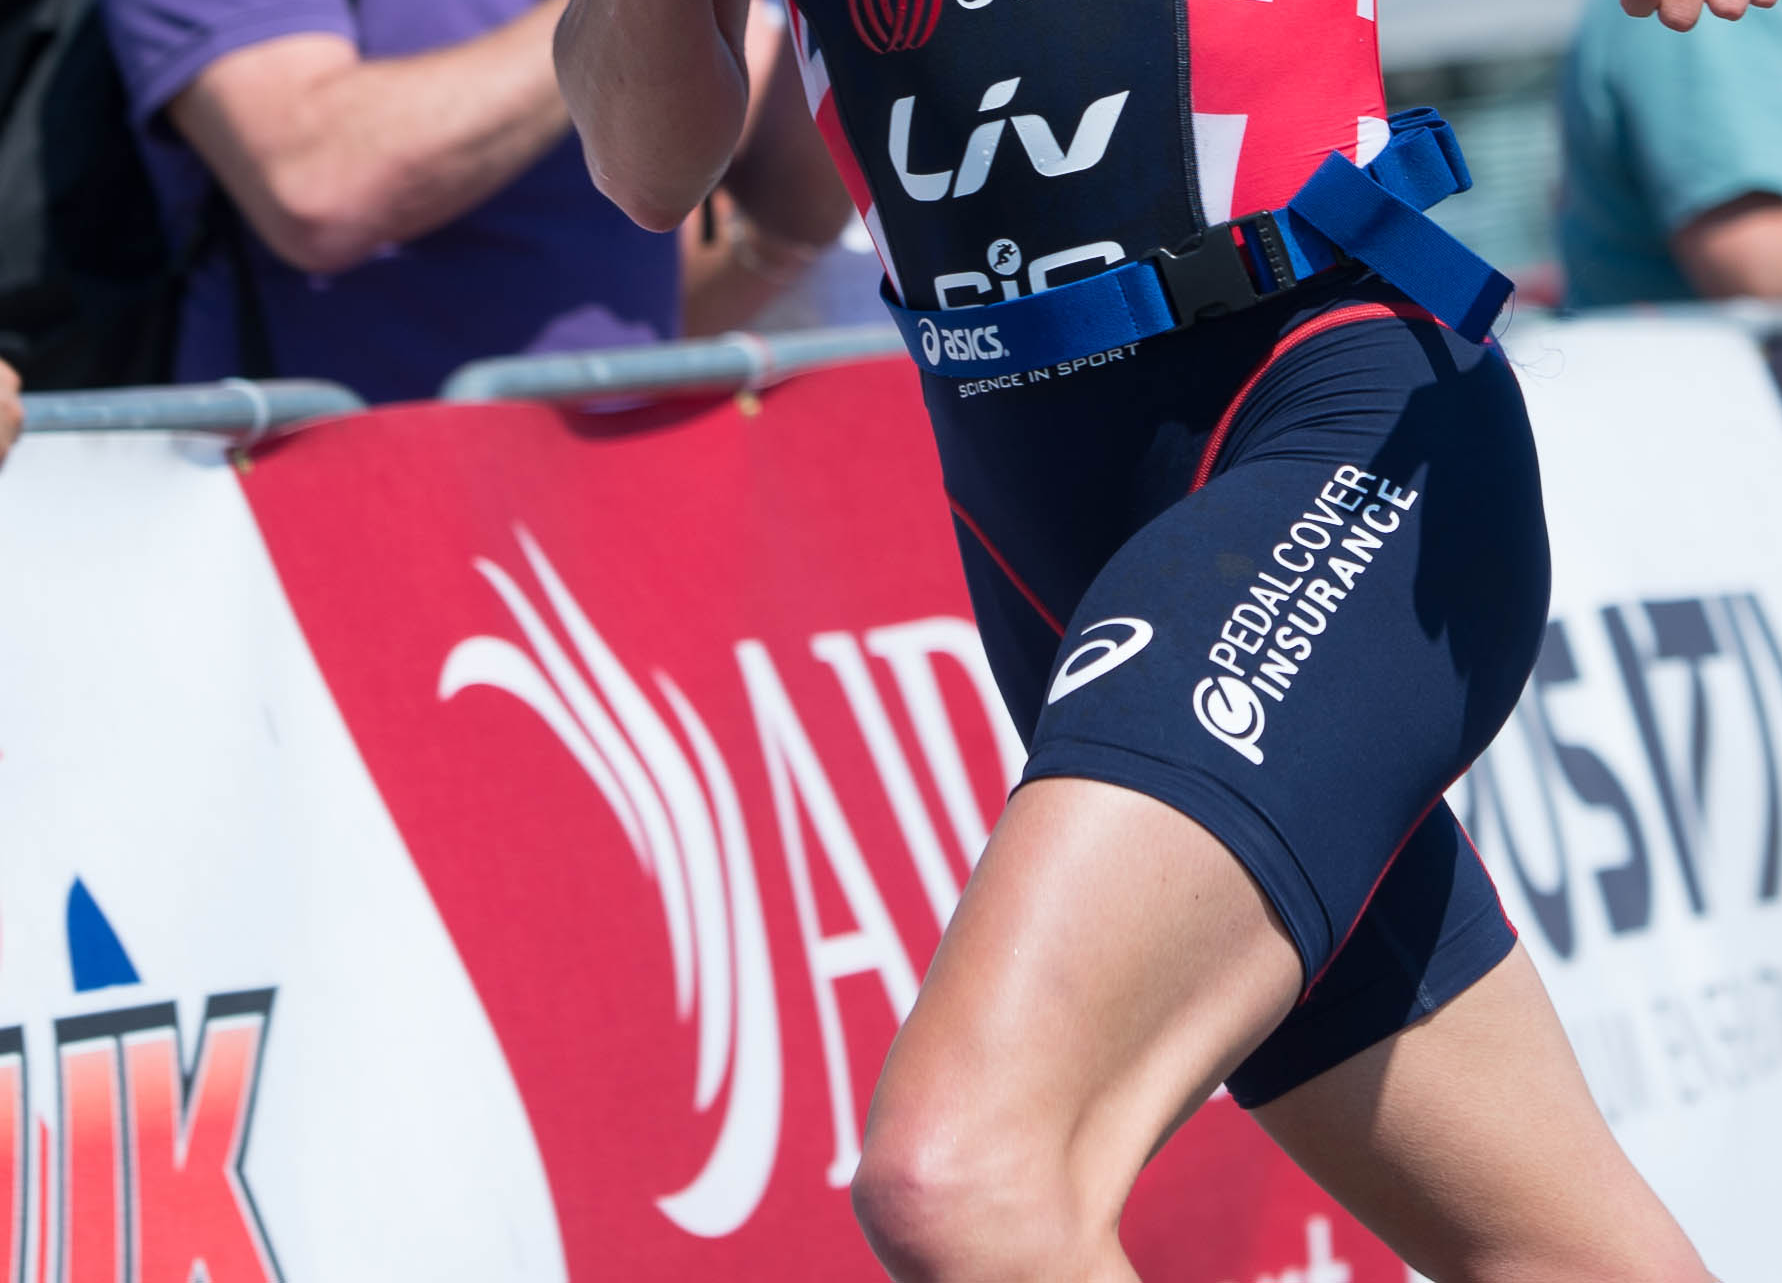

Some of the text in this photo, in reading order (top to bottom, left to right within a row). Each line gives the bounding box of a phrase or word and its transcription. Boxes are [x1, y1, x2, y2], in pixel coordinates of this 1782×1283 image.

[958, 342, 1140, 399] SCIENCE IN SPORT
[1250, 477, 1420, 703] INSURANCE
